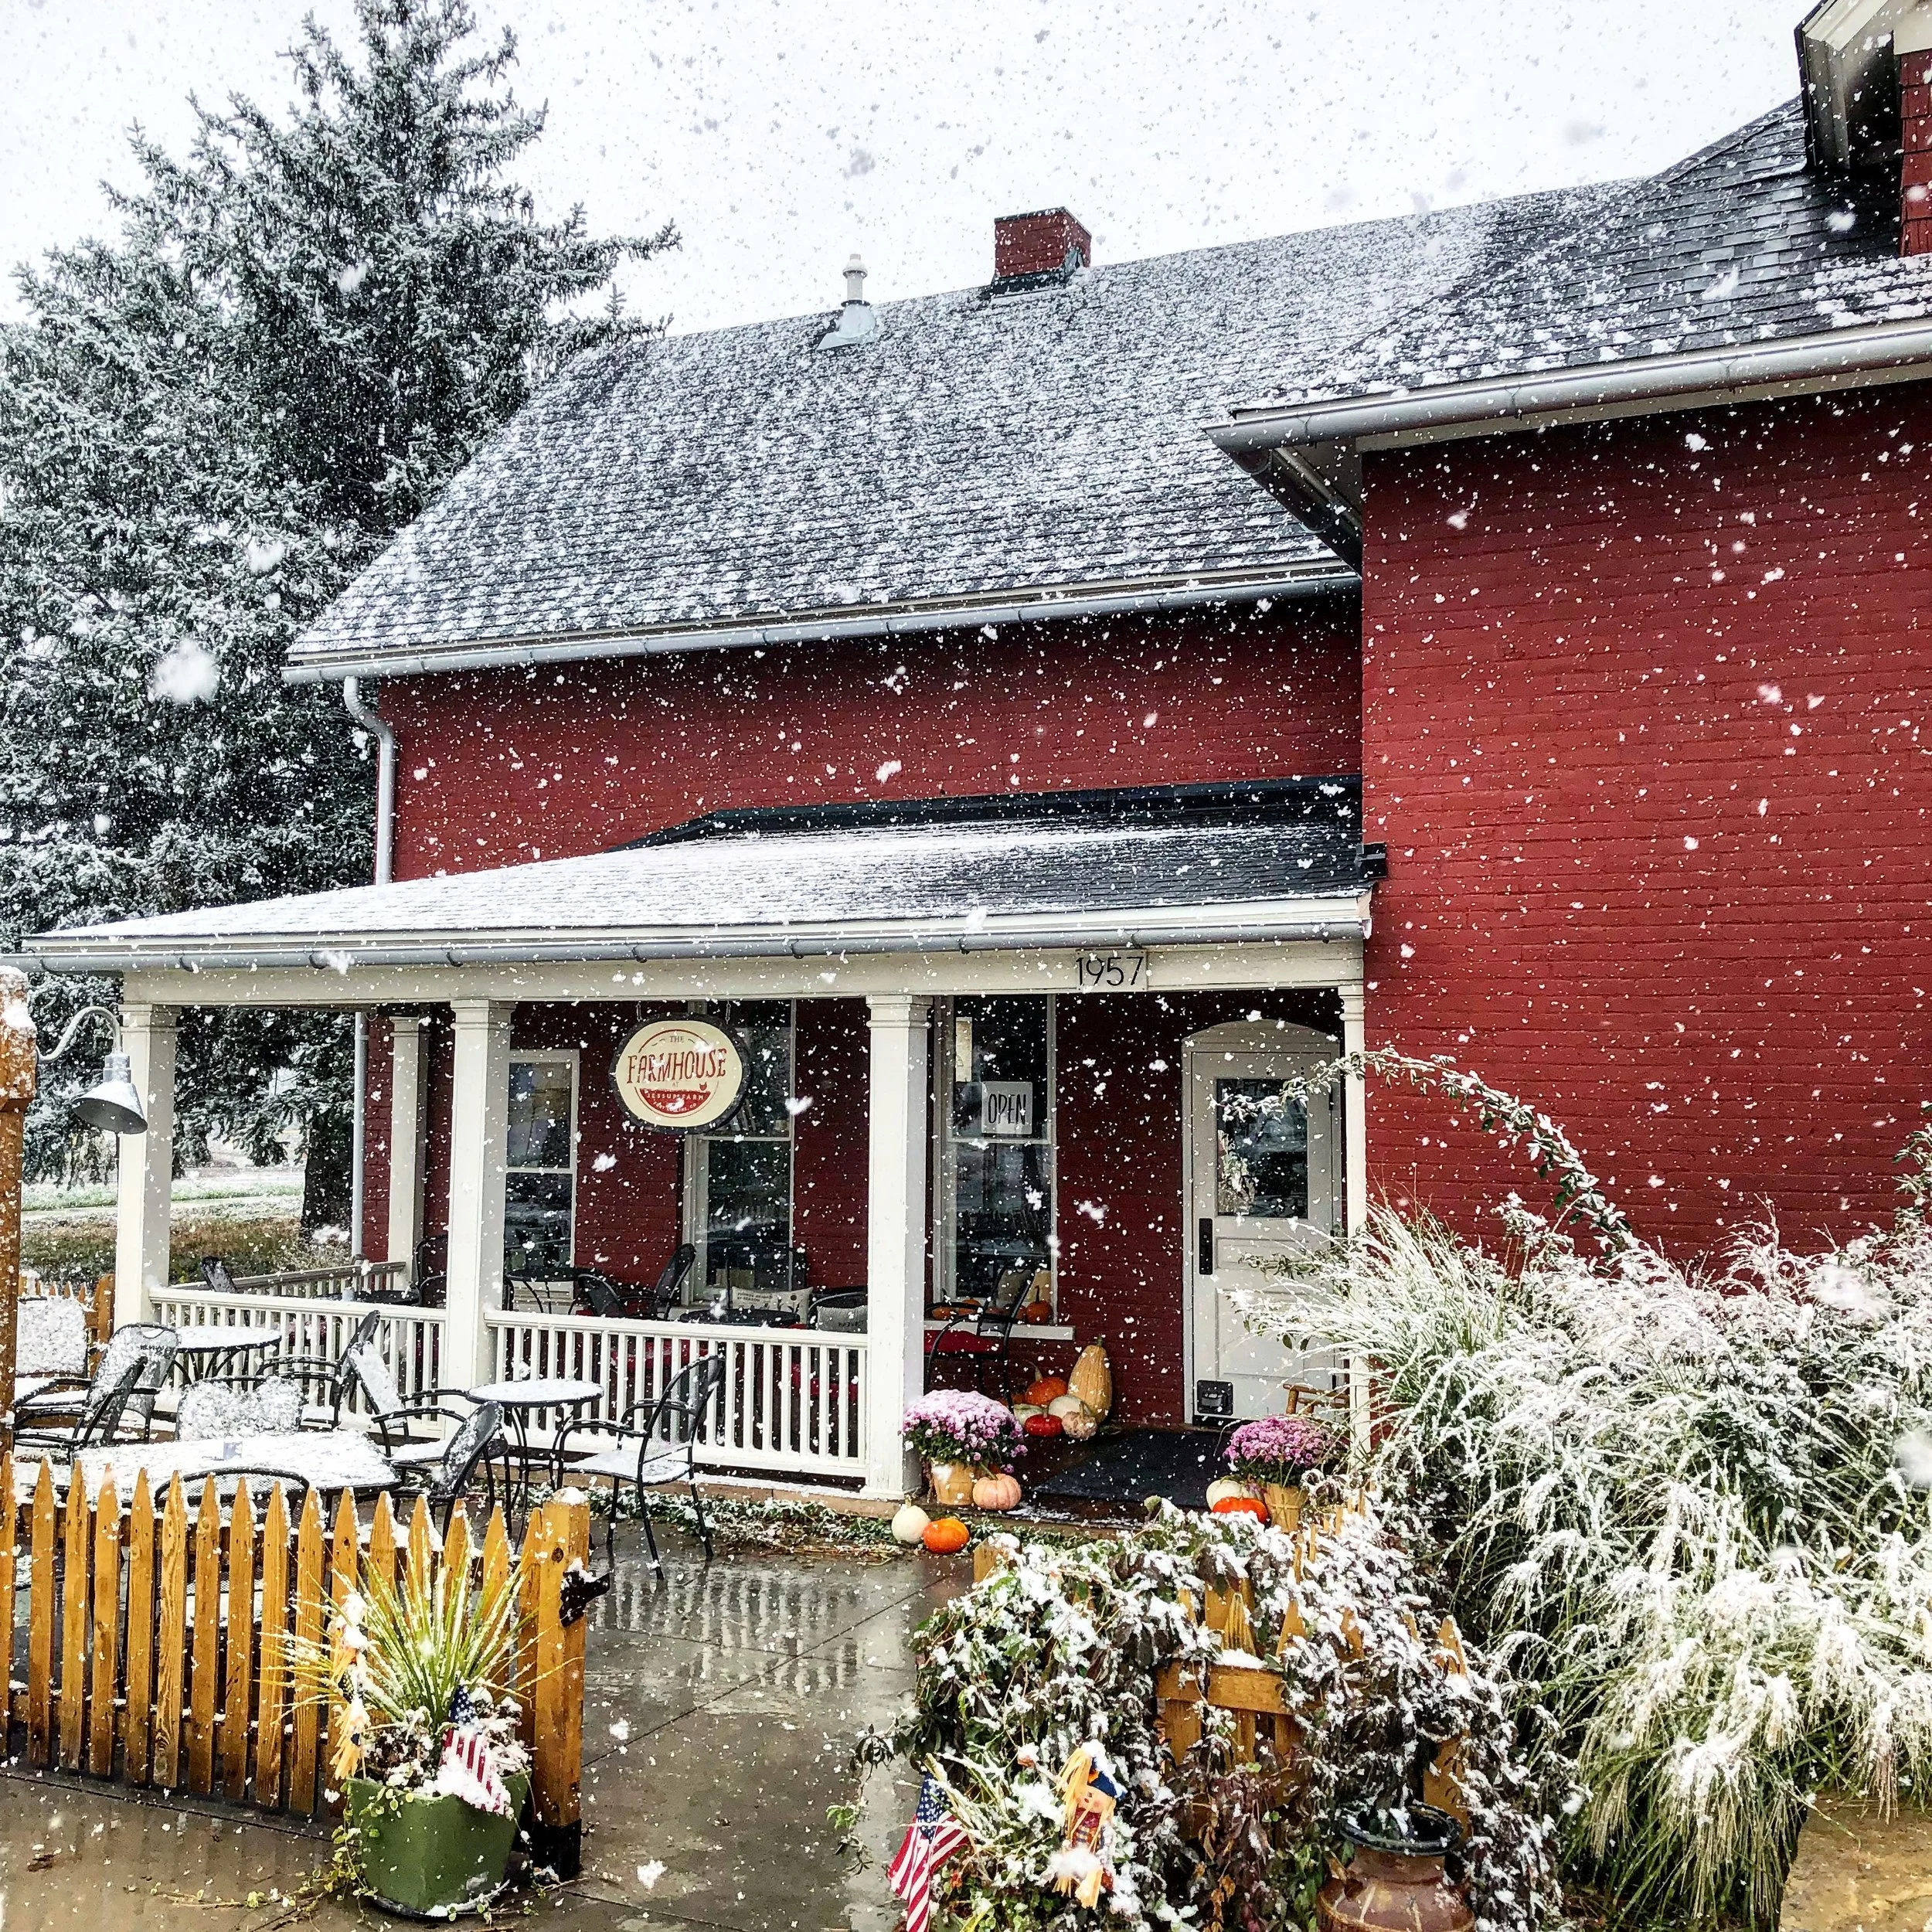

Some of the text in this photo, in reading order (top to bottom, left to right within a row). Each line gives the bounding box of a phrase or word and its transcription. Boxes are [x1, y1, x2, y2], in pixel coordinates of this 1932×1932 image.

[1075, 956, 1144, 986] 1957
[626, 1048, 727, 1083] FARMHOUSE
[988, 1094, 1026, 1125] OPEN
